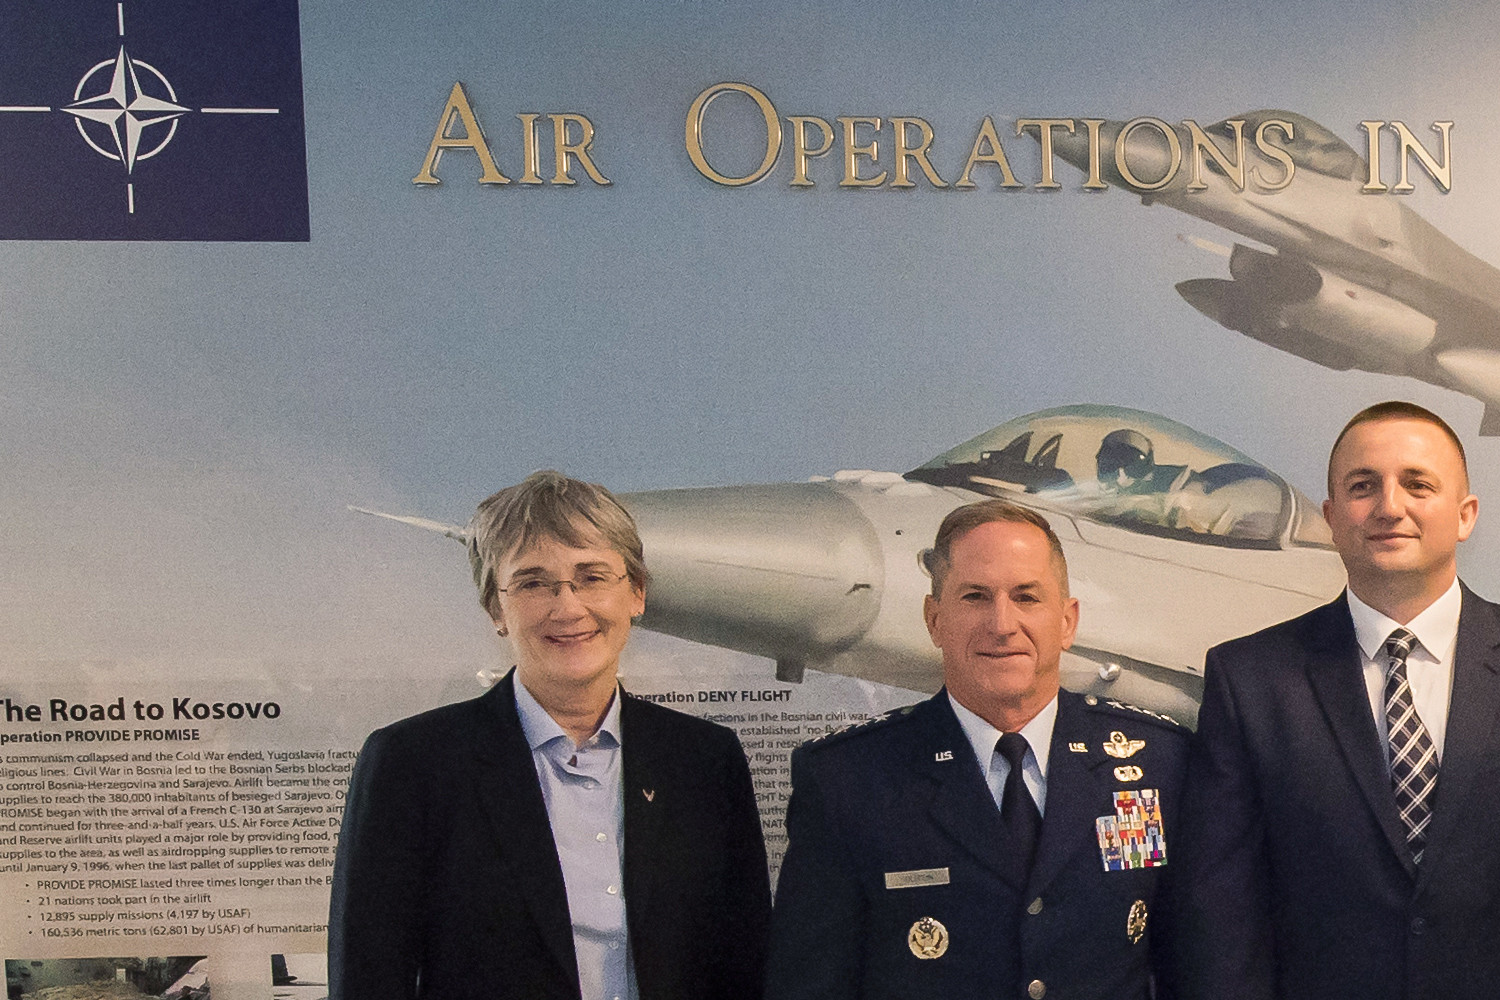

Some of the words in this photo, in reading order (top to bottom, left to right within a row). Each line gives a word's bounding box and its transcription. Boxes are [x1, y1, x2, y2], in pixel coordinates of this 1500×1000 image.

[411, 80, 613, 187] AIR
[684, 80, 1297, 194] OPERATIONS
[1359, 119, 1455, 195] IN
[698, 691, 736, 702] DENY
[741, 690, 792, 701] FLIGHT
[50, 698, 125, 722] Road
[133, 701, 164, 721] to
[172, 697, 281, 720] Kosovo
[703, 713, 745, 723] factions
[760, 713, 777, 722] the
[781, 712, 823, 722] Bosnian
[0, 730, 62, 746] peration
[65, 730, 131, 742] PROVIDE
[134, 729, 200, 741] PROMISE
[740, 725, 800, 736] established
[6, 752, 74, 763] communism
[76, 751, 128, 765] collapsed
[131, 751, 151, 761] and
[155, 750, 173, 761] the
[176, 750, 200, 761] Cold
[204, 750, 224, 760] War
[267, 748, 325, 761] Yugoslavia
[755, 752, 788, 764] flights
[73, 766, 96, 776] Civil
[99, 765, 120, 776] War
[136, 764, 172, 775] Bosnia
[209, 764, 226, 774] the
[230, 763, 272, 774] Bosnian
[275, 763, 305, 773] Serbs
[6, 780, 45, 790] control
[48, 778, 156, 792] Bosnia-Herzegovina
[159, 778, 179, 788] and
[267, 776, 310, 787] became
[312, 776, 330, 786] the
[88, 792, 105, 803] the
[232, 790, 281, 803] besieged
[46, 807, 81, 820] began
[83, 806, 107, 817] with
[111, 806, 128, 816] the
[131, 805, 165, 816] arrival
[190, 804, 226, 815] French
[277, 803, 323, 816] Sarajevo
[19, 820, 74, 831] continued
[77, 820, 91, 830] for
[219, 818, 239, 828] U.S.
[242, 817, 256, 828] Air
[260, 817, 289, 827] Force
[292, 816, 326, 827] Active
[20, 834, 62, 845] Reserve
[65, 833, 92, 844] airlift
[126, 832, 161, 845] played
[173, 834, 204, 845] major
[207, 831, 228, 842] role
[247, 830, 300, 844] providing
[59, 848, 77, 858] the
[161, 845, 226, 859] airdropping
[229, 844, 273, 857] supplies
[290, 843, 330, 854] remote
[25, 861, 67, 874] January
[115, 860, 145, 870] when
[148, 859, 166, 870] the
[169, 859, 187, 869] last
[190, 858, 220, 871] pallet
[237, 857, 282, 871] supplies
[284, 859, 306, 867] was
[37, 879, 85, 890] PROVIDE
[88, 878, 137, 889] PROMISE
[141, 878, 173, 888] lasted
[175, 877, 204, 888] three
[206, 877, 236, 887] times
[239, 876, 275, 889] longer
[277, 876, 302, 886] than
[305, 875, 322, 886] the
[54, 894, 94, 905] nations
[97, 894, 123, 905] took
[125, 894, 147, 906] part
[163, 893, 181, 903] the
[183, 893, 211, 903] airlift
[40, 911, 75, 923] 12,895
[78, 910, 115, 923] supply
[117, 909, 164, 920] missions
[218, 908, 251, 921] USAF)
[85, 925, 120, 936] metric
[123, 925, 147, 936] tons
[208, 923, 241, 936] USAF)
[257, 922, 329, 933] humanitarian
